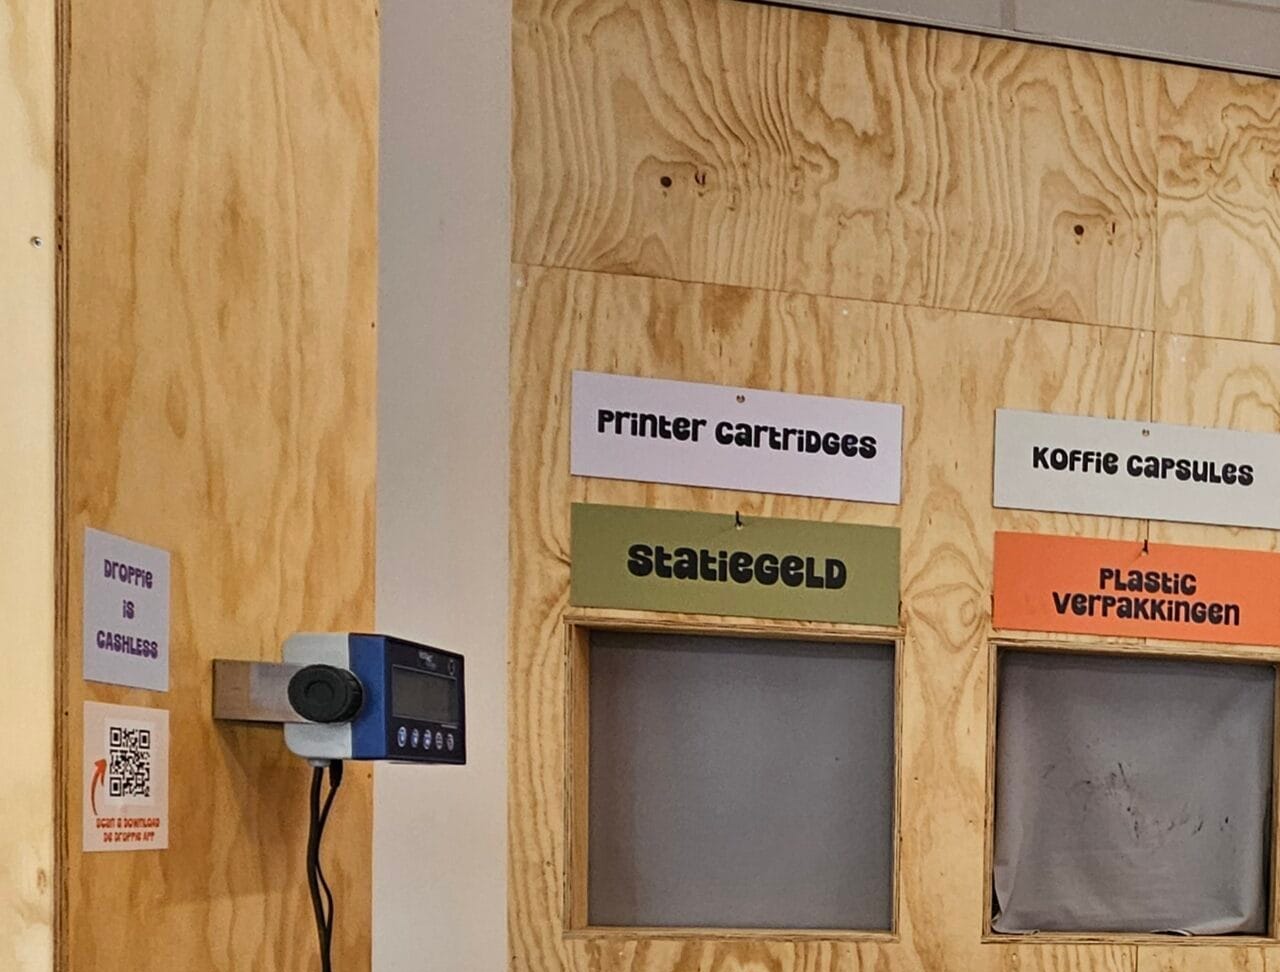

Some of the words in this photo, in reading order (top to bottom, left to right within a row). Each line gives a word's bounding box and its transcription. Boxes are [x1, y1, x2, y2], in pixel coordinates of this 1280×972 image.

[598, 408, 706, 442] Printer
[104, 558, 153, 589] Droppie
[122, 600, 134, 619] is
[97, 630, 158, 659] CASHLESS
